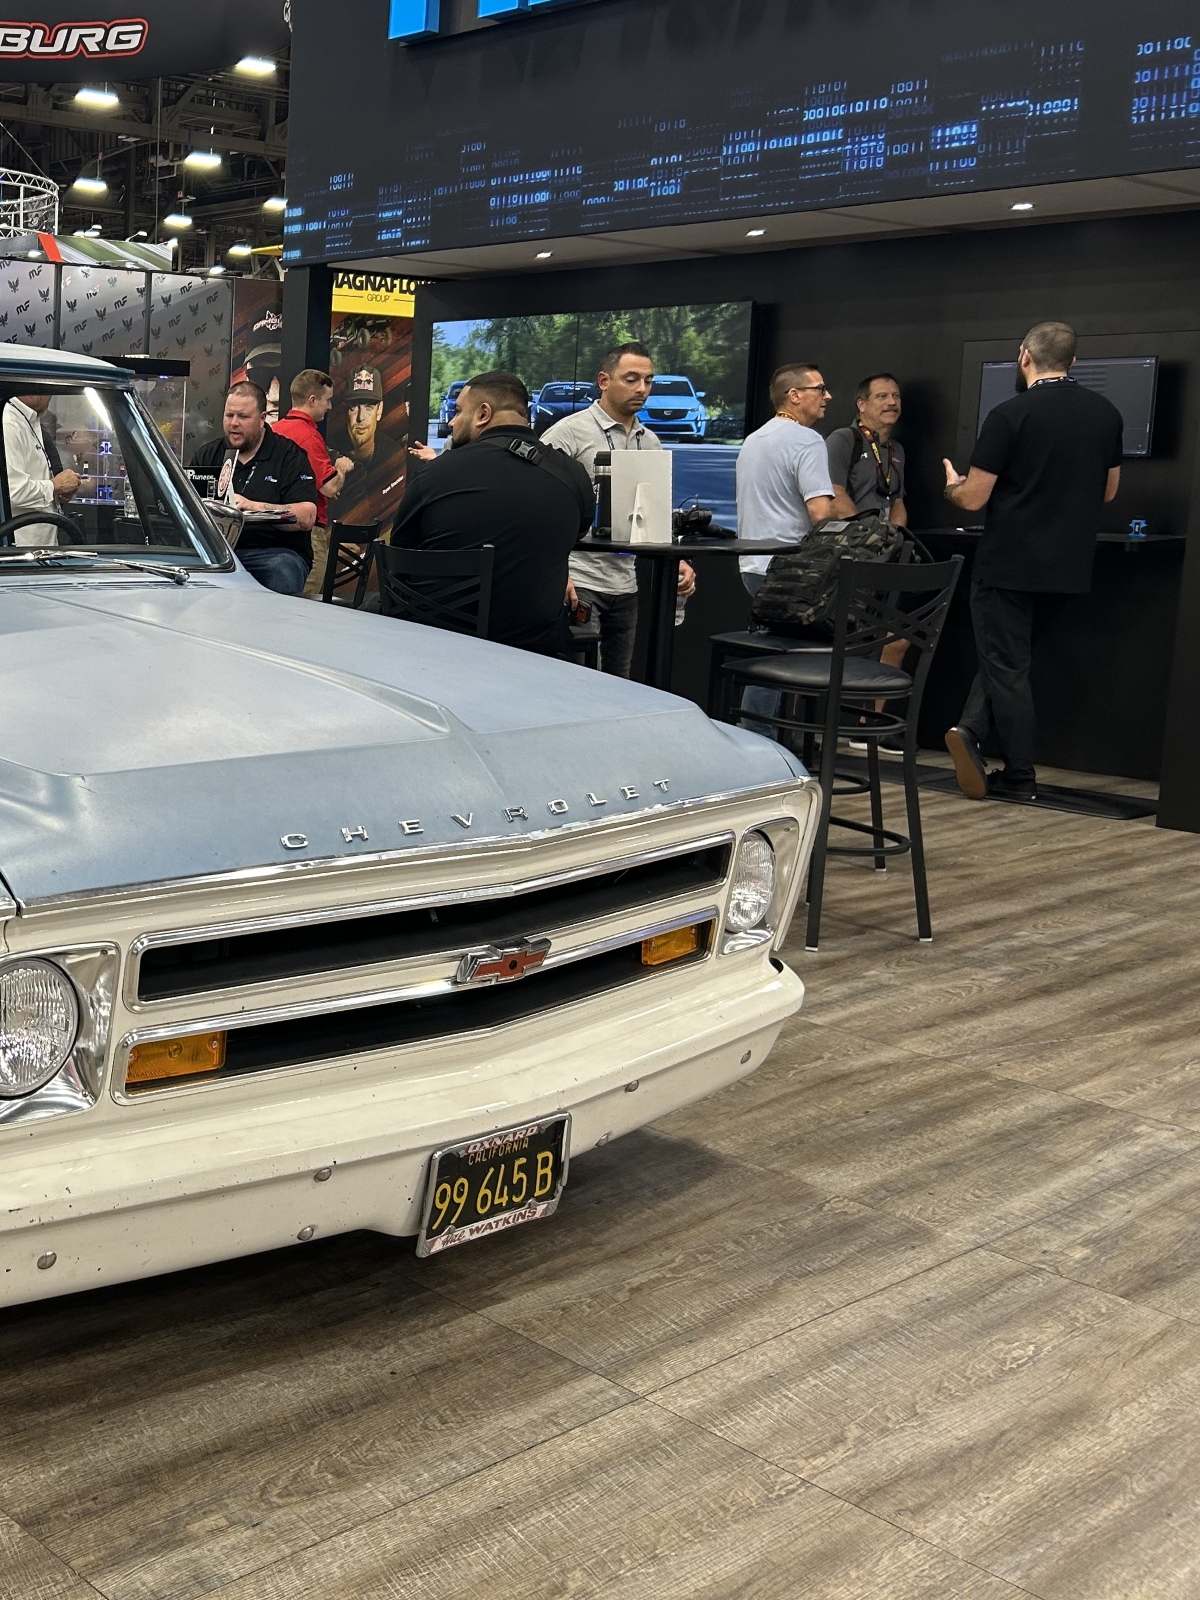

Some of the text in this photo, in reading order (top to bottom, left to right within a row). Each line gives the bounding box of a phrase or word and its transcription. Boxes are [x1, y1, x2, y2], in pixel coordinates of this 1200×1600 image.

[366, 293, 388, 303] GROUP
[279, 778, 671, 850] CHEVROLET
[466, 1124, 541, 1154] OXNARD
[468, 1137, 530, 1166] CALIFORNIA
[431, 1150, 554, 1231] 99 645 B
[468, 1206, 538, 1237] WATKINS
